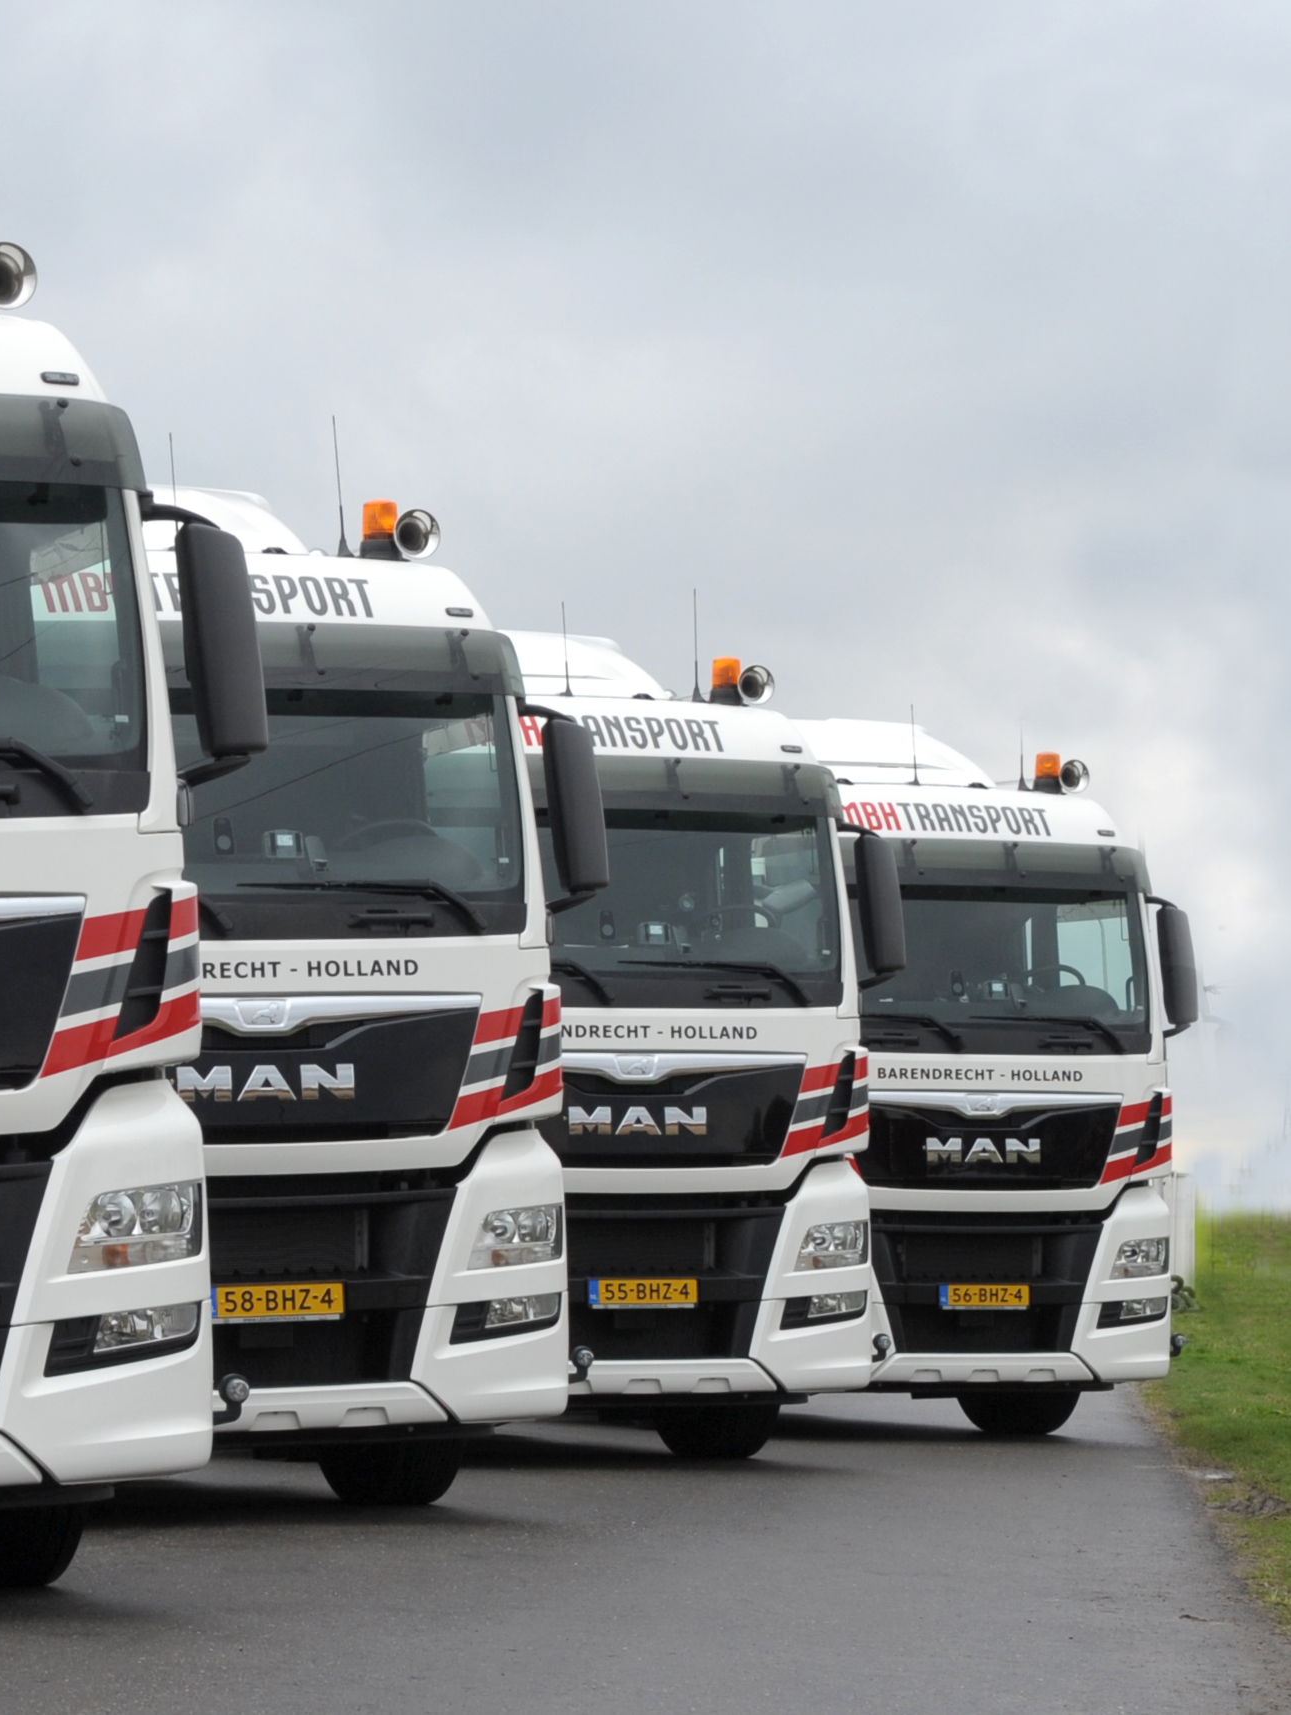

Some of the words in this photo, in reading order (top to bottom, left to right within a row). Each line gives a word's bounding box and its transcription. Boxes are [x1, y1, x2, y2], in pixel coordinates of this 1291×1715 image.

[307, 959, 420, 977] HOLLAND
[561, 1024, 651, 1039] NDRECHT
[670, 1025, 758, 1040] HOLLAND
[176, 1063, 356, 1103] MAN
[877, 1067, 995, 1081] BARENDRECHT
[1011, 1069, 1083, 1082] HOLLAND
[568, 1106, 707, 1135] MAN
[925, 1137, 1041, 1163] MAN
[224, 1287, 334, 1313] 58-BHZ-4
[604, 1282, 690, 1301] 55-BHZ-4
[952, 1287, 1023, 1303] 56-BHZ-4
